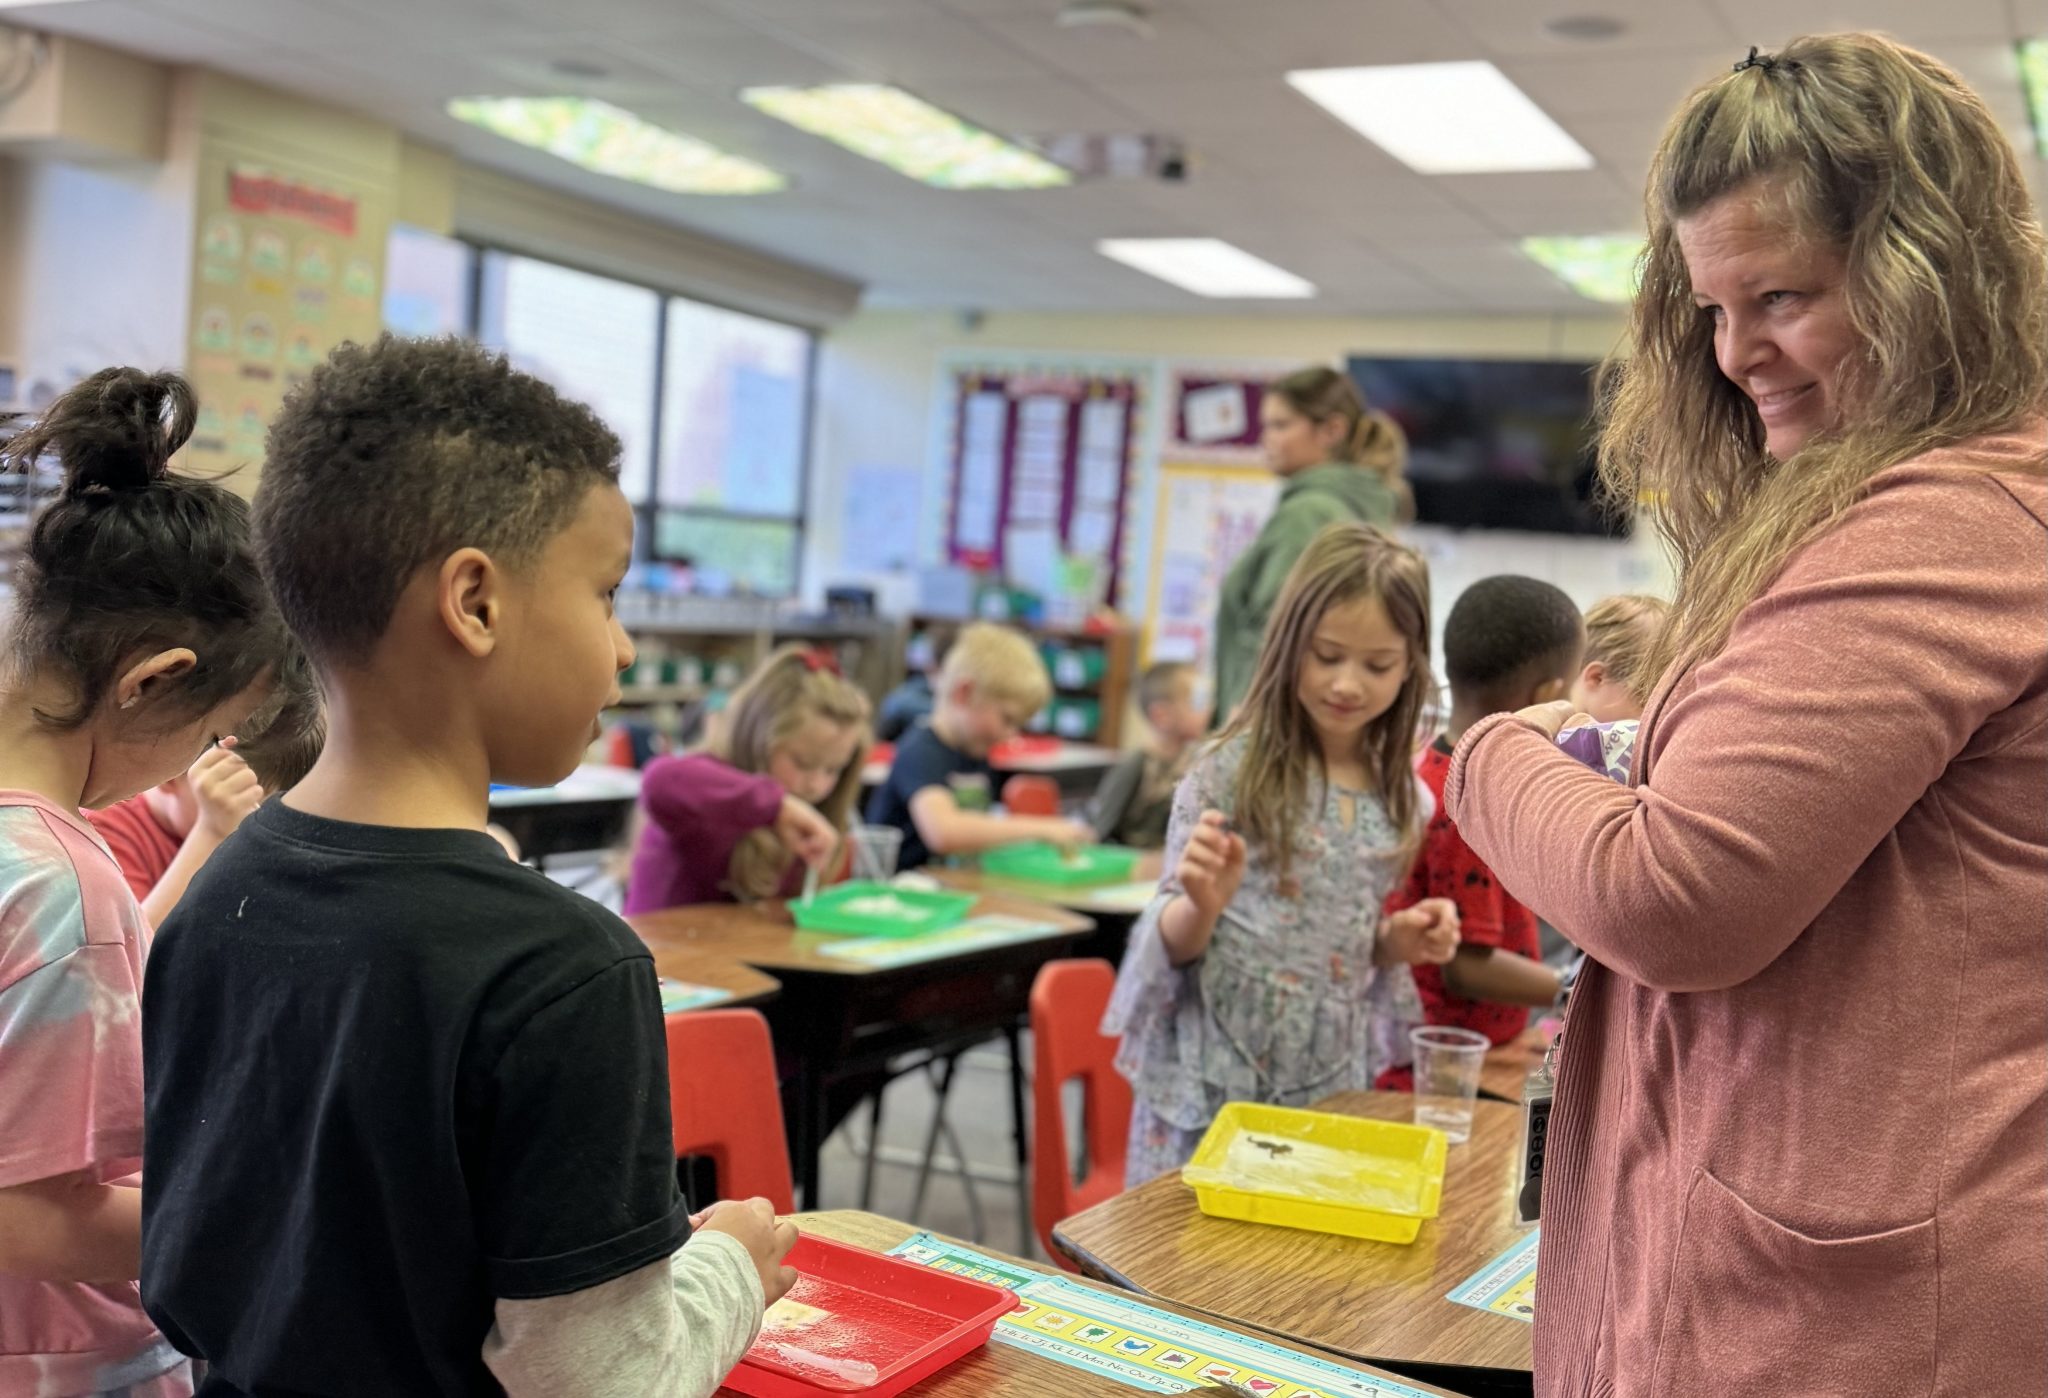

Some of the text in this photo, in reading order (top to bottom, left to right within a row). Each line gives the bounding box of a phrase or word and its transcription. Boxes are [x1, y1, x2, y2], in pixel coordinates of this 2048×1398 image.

[1081, 1354, 1104, 1365] Mm
[1107, 1362, 1124, 1371] Nn
[1148, 1375, 1166, 1385] Pp
